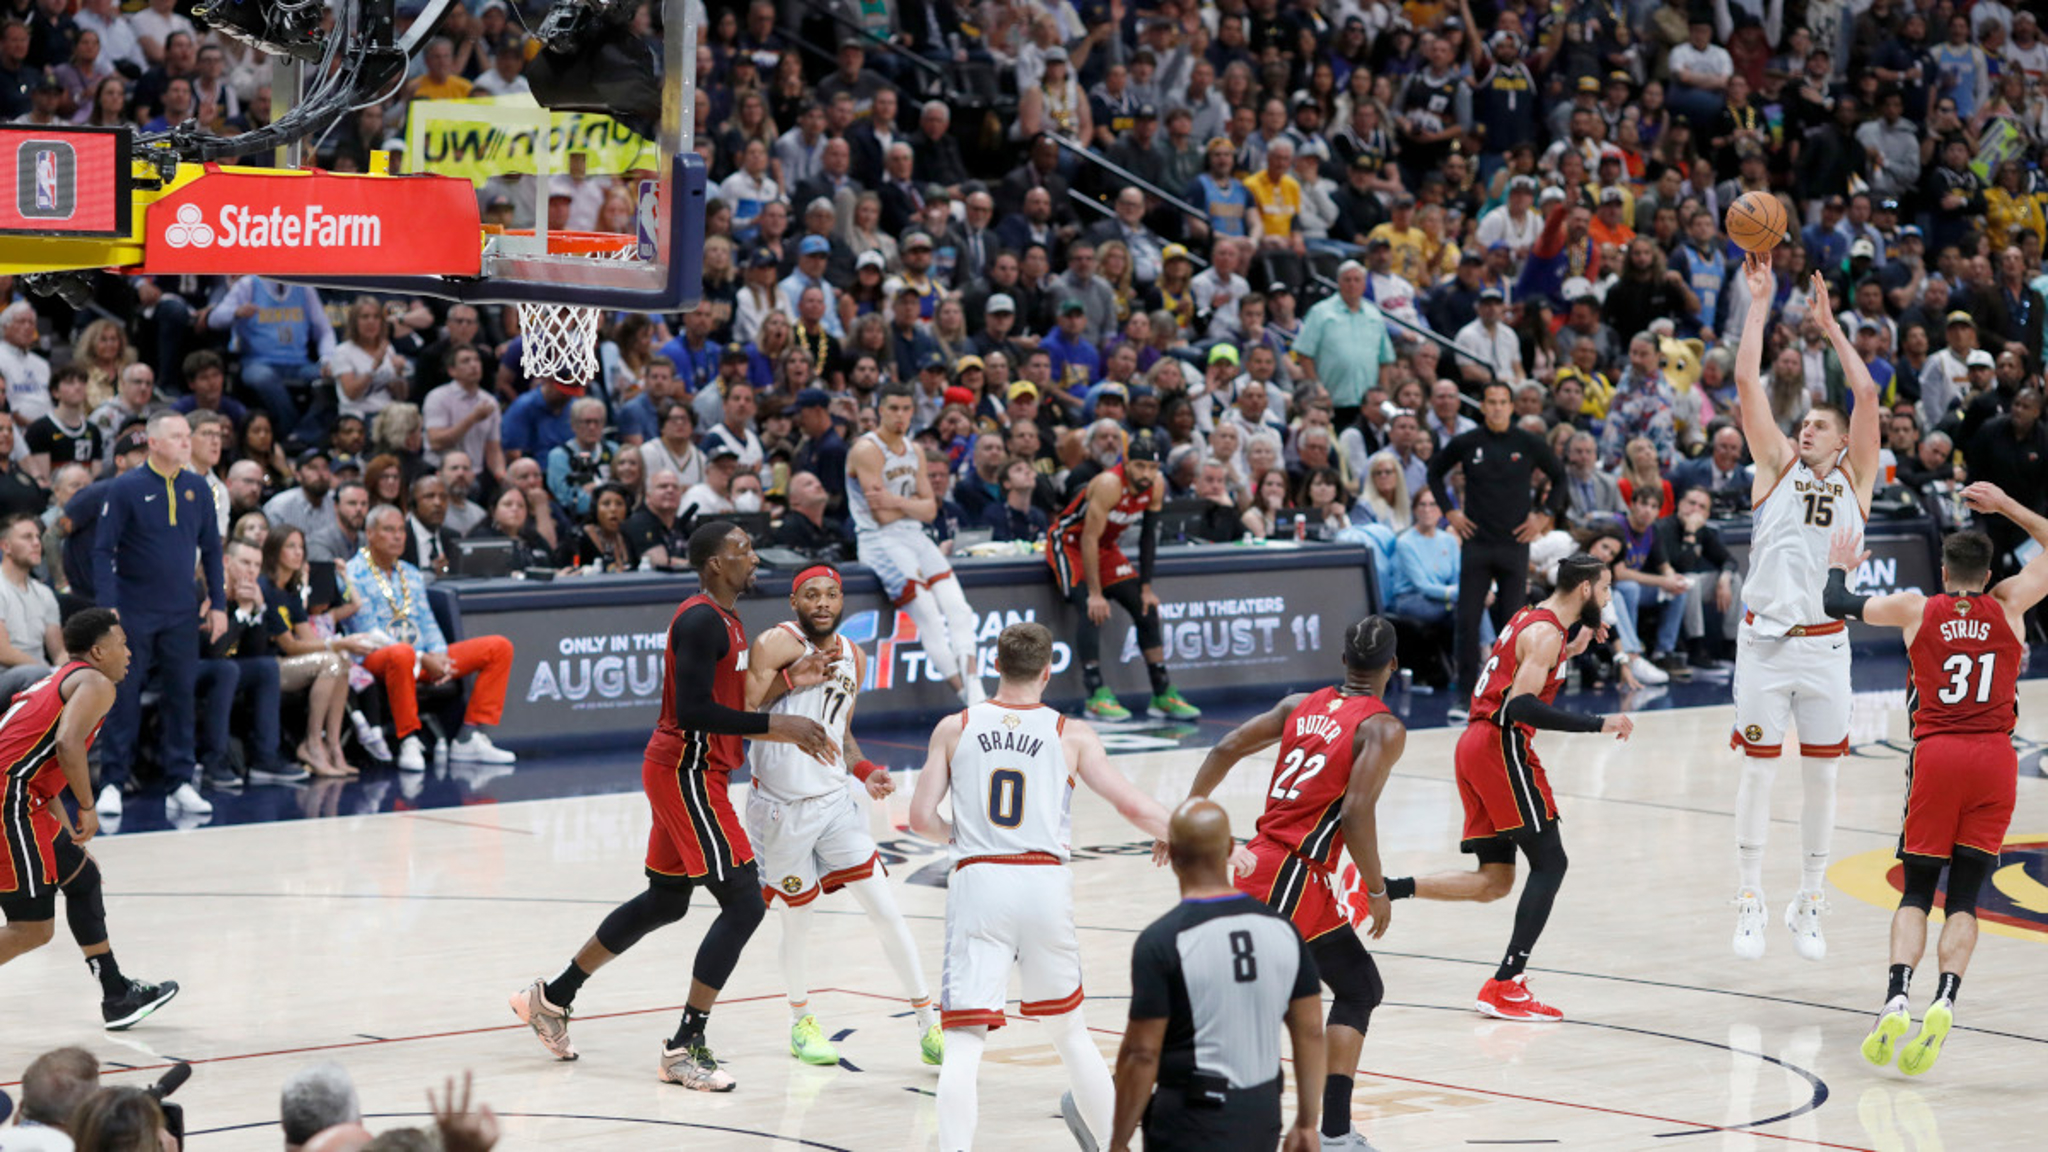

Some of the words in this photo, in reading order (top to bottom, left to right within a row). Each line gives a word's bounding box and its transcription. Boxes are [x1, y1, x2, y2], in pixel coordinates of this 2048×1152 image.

[1804, 492, 1834, 528] 15
[1158, 602, 1187, 620] NLY
[1189, 601, 1205, 618] IN
[1207, 597, 1285, 617] THEATERS
[559, 636, 607, 656] ONLY
[610, 634, 629, 652] IN
[1291, 614, 1321, 652] 11
[1940, 619, 1991, 642] STRUS
[526, 654, 666, 702] AUGU
[1937, 651, 1996, 705] 31
[821, 686, 847, 725] 11
[977, 729, 1044, 758] BRAUN
[1296, 714, 1342, 745] BUTLER
[1270, 746, 1326, 801] 22
[987, 766, 1026, 830] 0
[1229, 929, 1258, 984] 8
